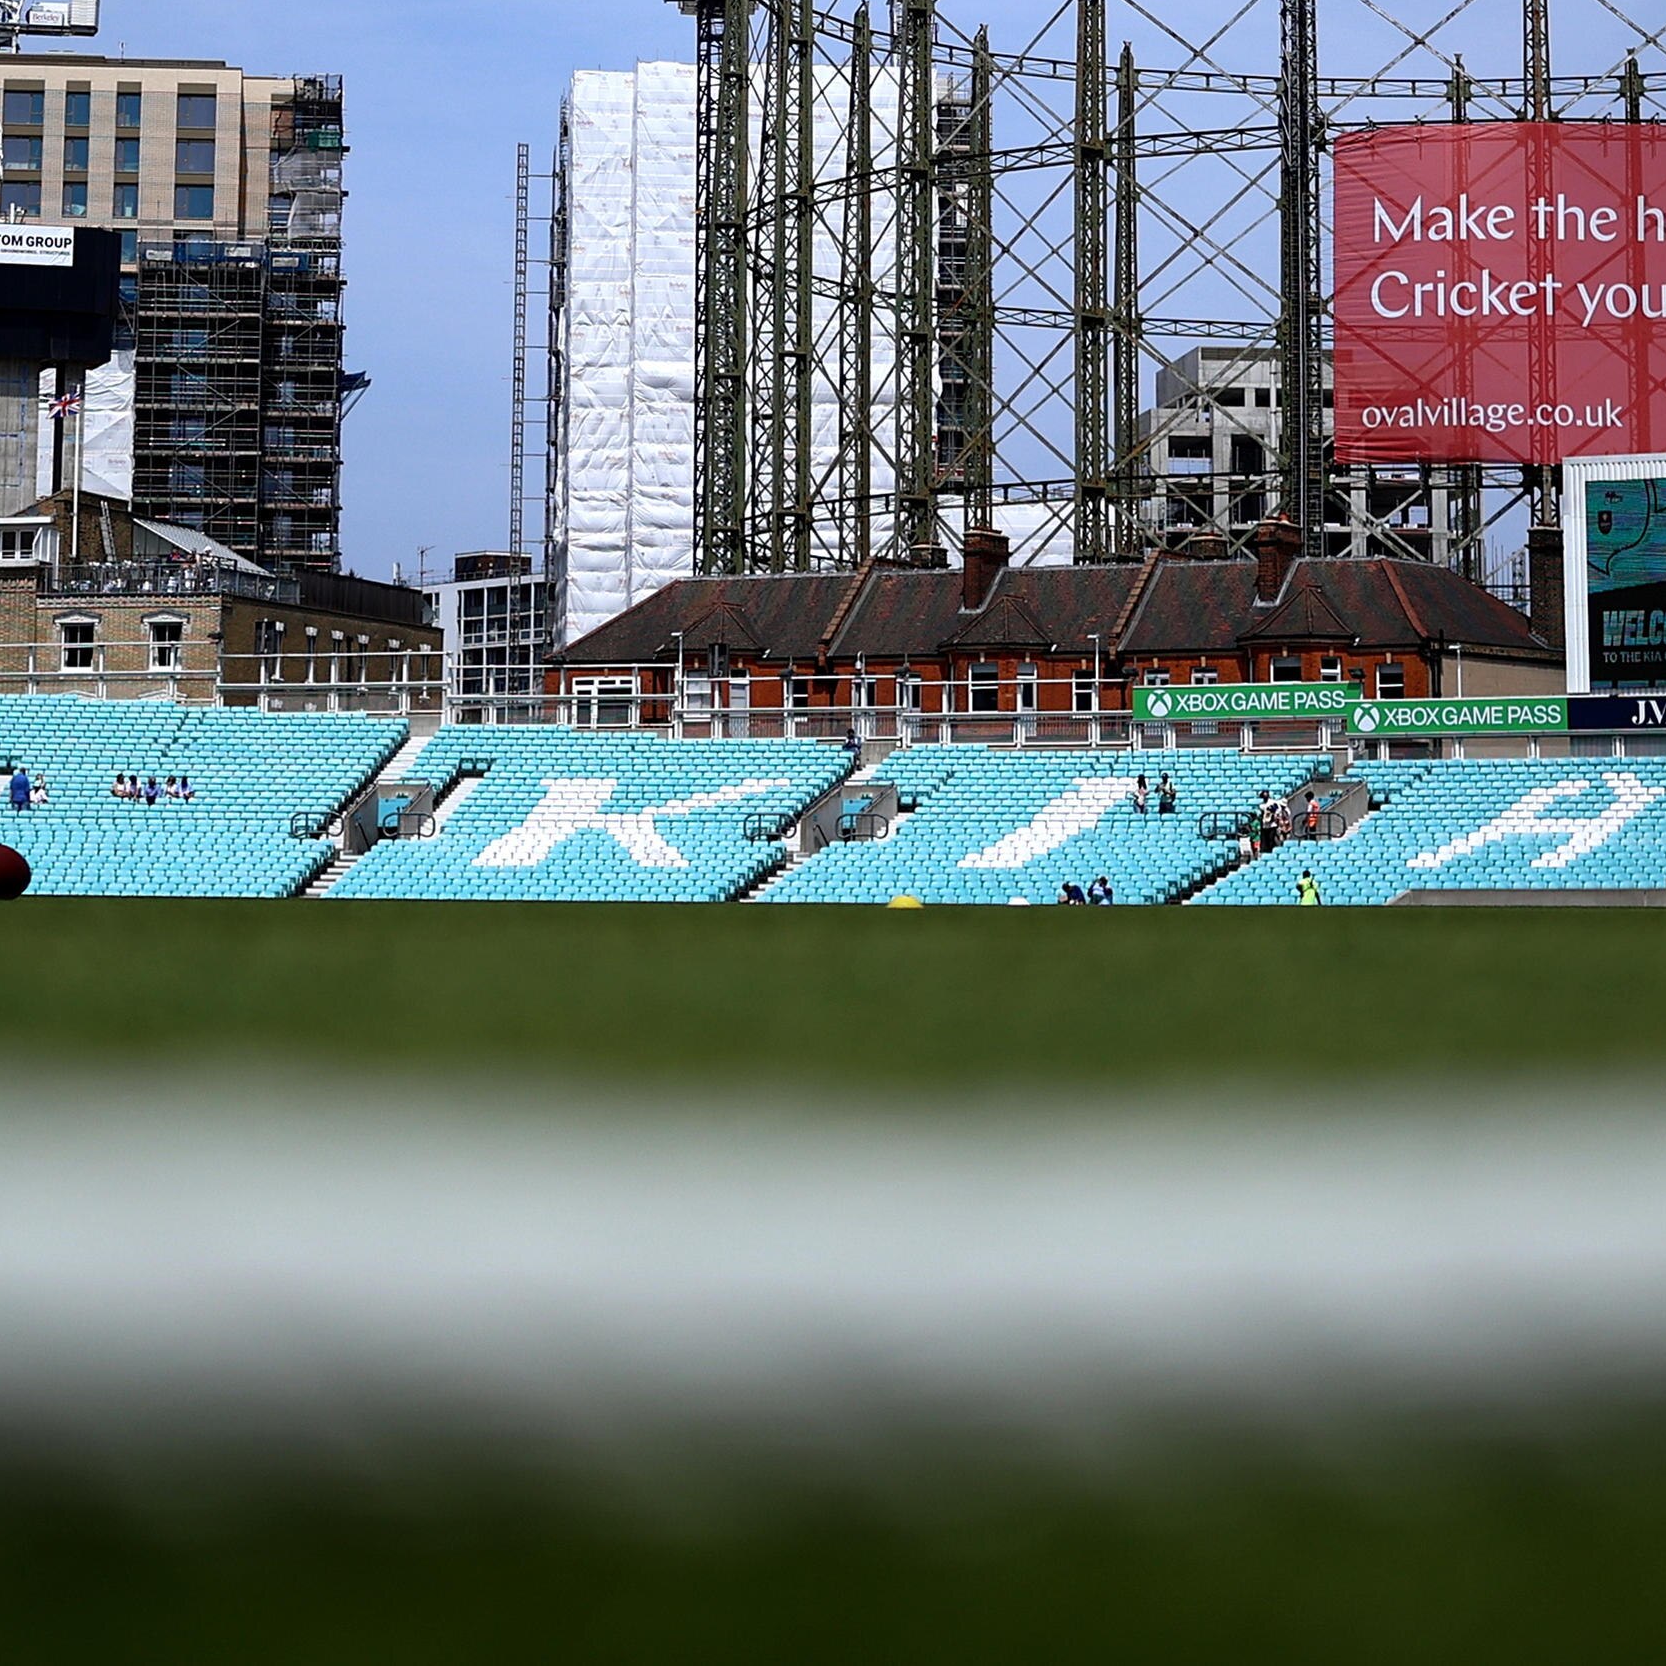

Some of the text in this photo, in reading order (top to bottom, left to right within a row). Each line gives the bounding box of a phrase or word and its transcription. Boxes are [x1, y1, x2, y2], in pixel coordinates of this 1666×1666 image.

[1374, 193, 1515, 243] Make
[1531, 193, 1618, 242] the
[25, 236, 72, 249] GROUP
[1370, 269, 1562, 319] Cricket
[1362, 397, 1624, 432] ovalvillage.co.uk
[1603, 652, 1618, 663] TO
[1620, 651, 1641, 663] THE
[1176, 690, 1346, 712] XBOX GAME PASS
[1384, 705, 1561, 726] XBOX GAME PASS
